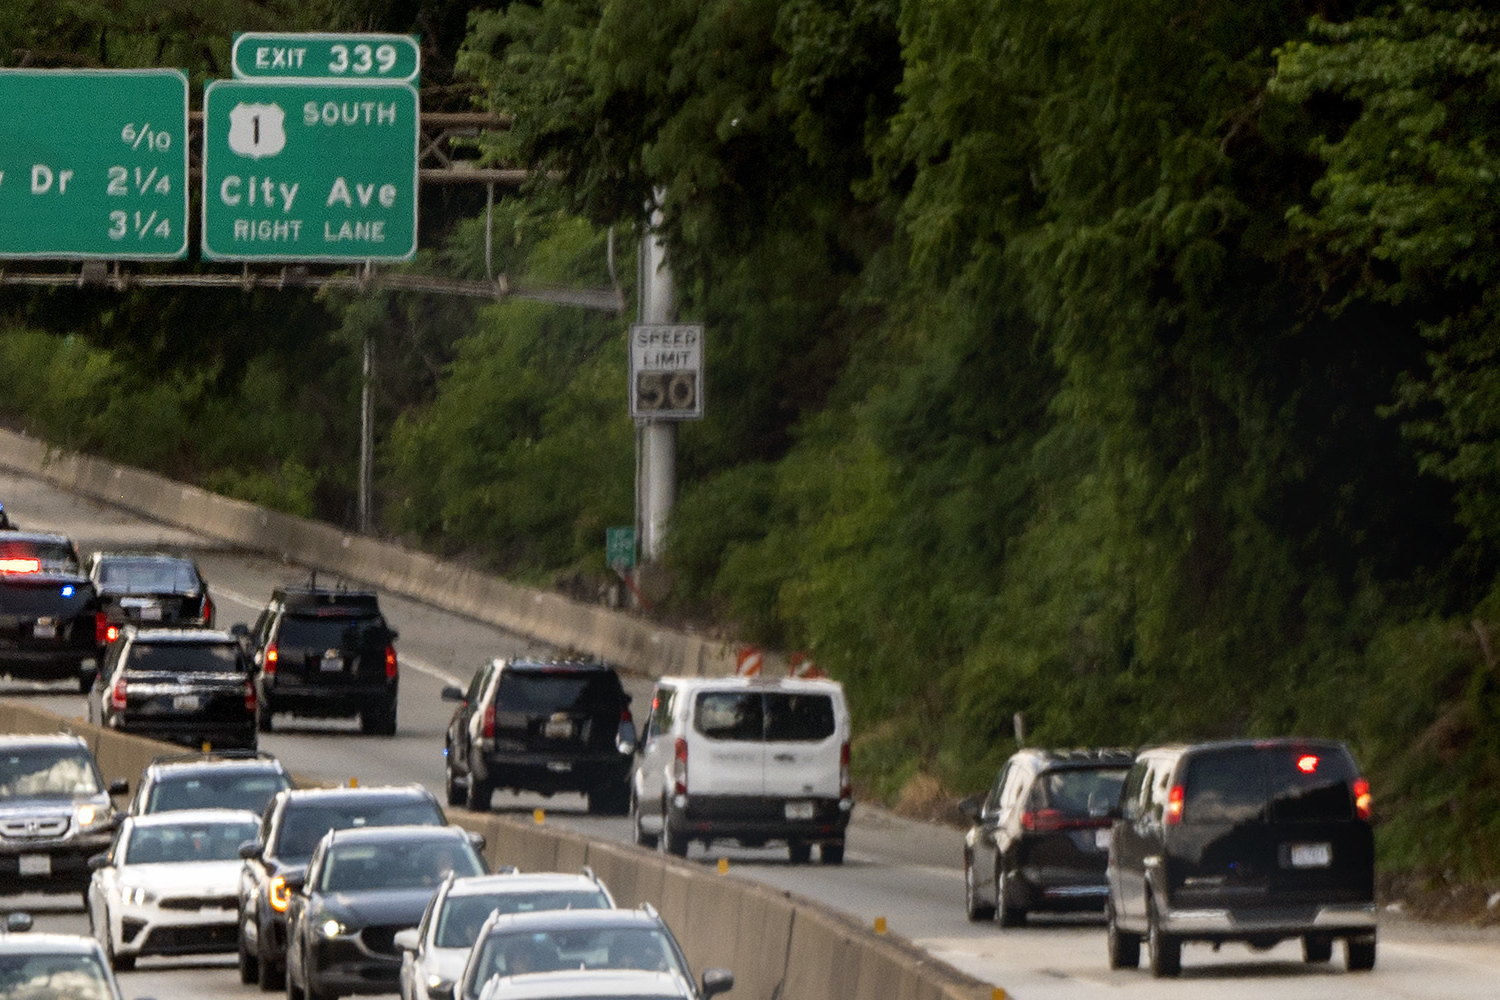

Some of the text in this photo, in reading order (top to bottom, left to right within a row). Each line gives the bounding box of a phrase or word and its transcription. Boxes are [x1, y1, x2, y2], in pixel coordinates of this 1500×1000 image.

[255, 43, 397, 74] EXIT 339
[303, 101, 397, 126] SOUTH
[121, 123, 172, 151] 6/10
[30, 163, 74, 195] Dr
[220, 175, 397, 213] City Ave
[233, 218, 386, 243] RIGHT LANE
[637, 331, 696, 347] SPEED
[644, 351, 690, 365] LIMIT
